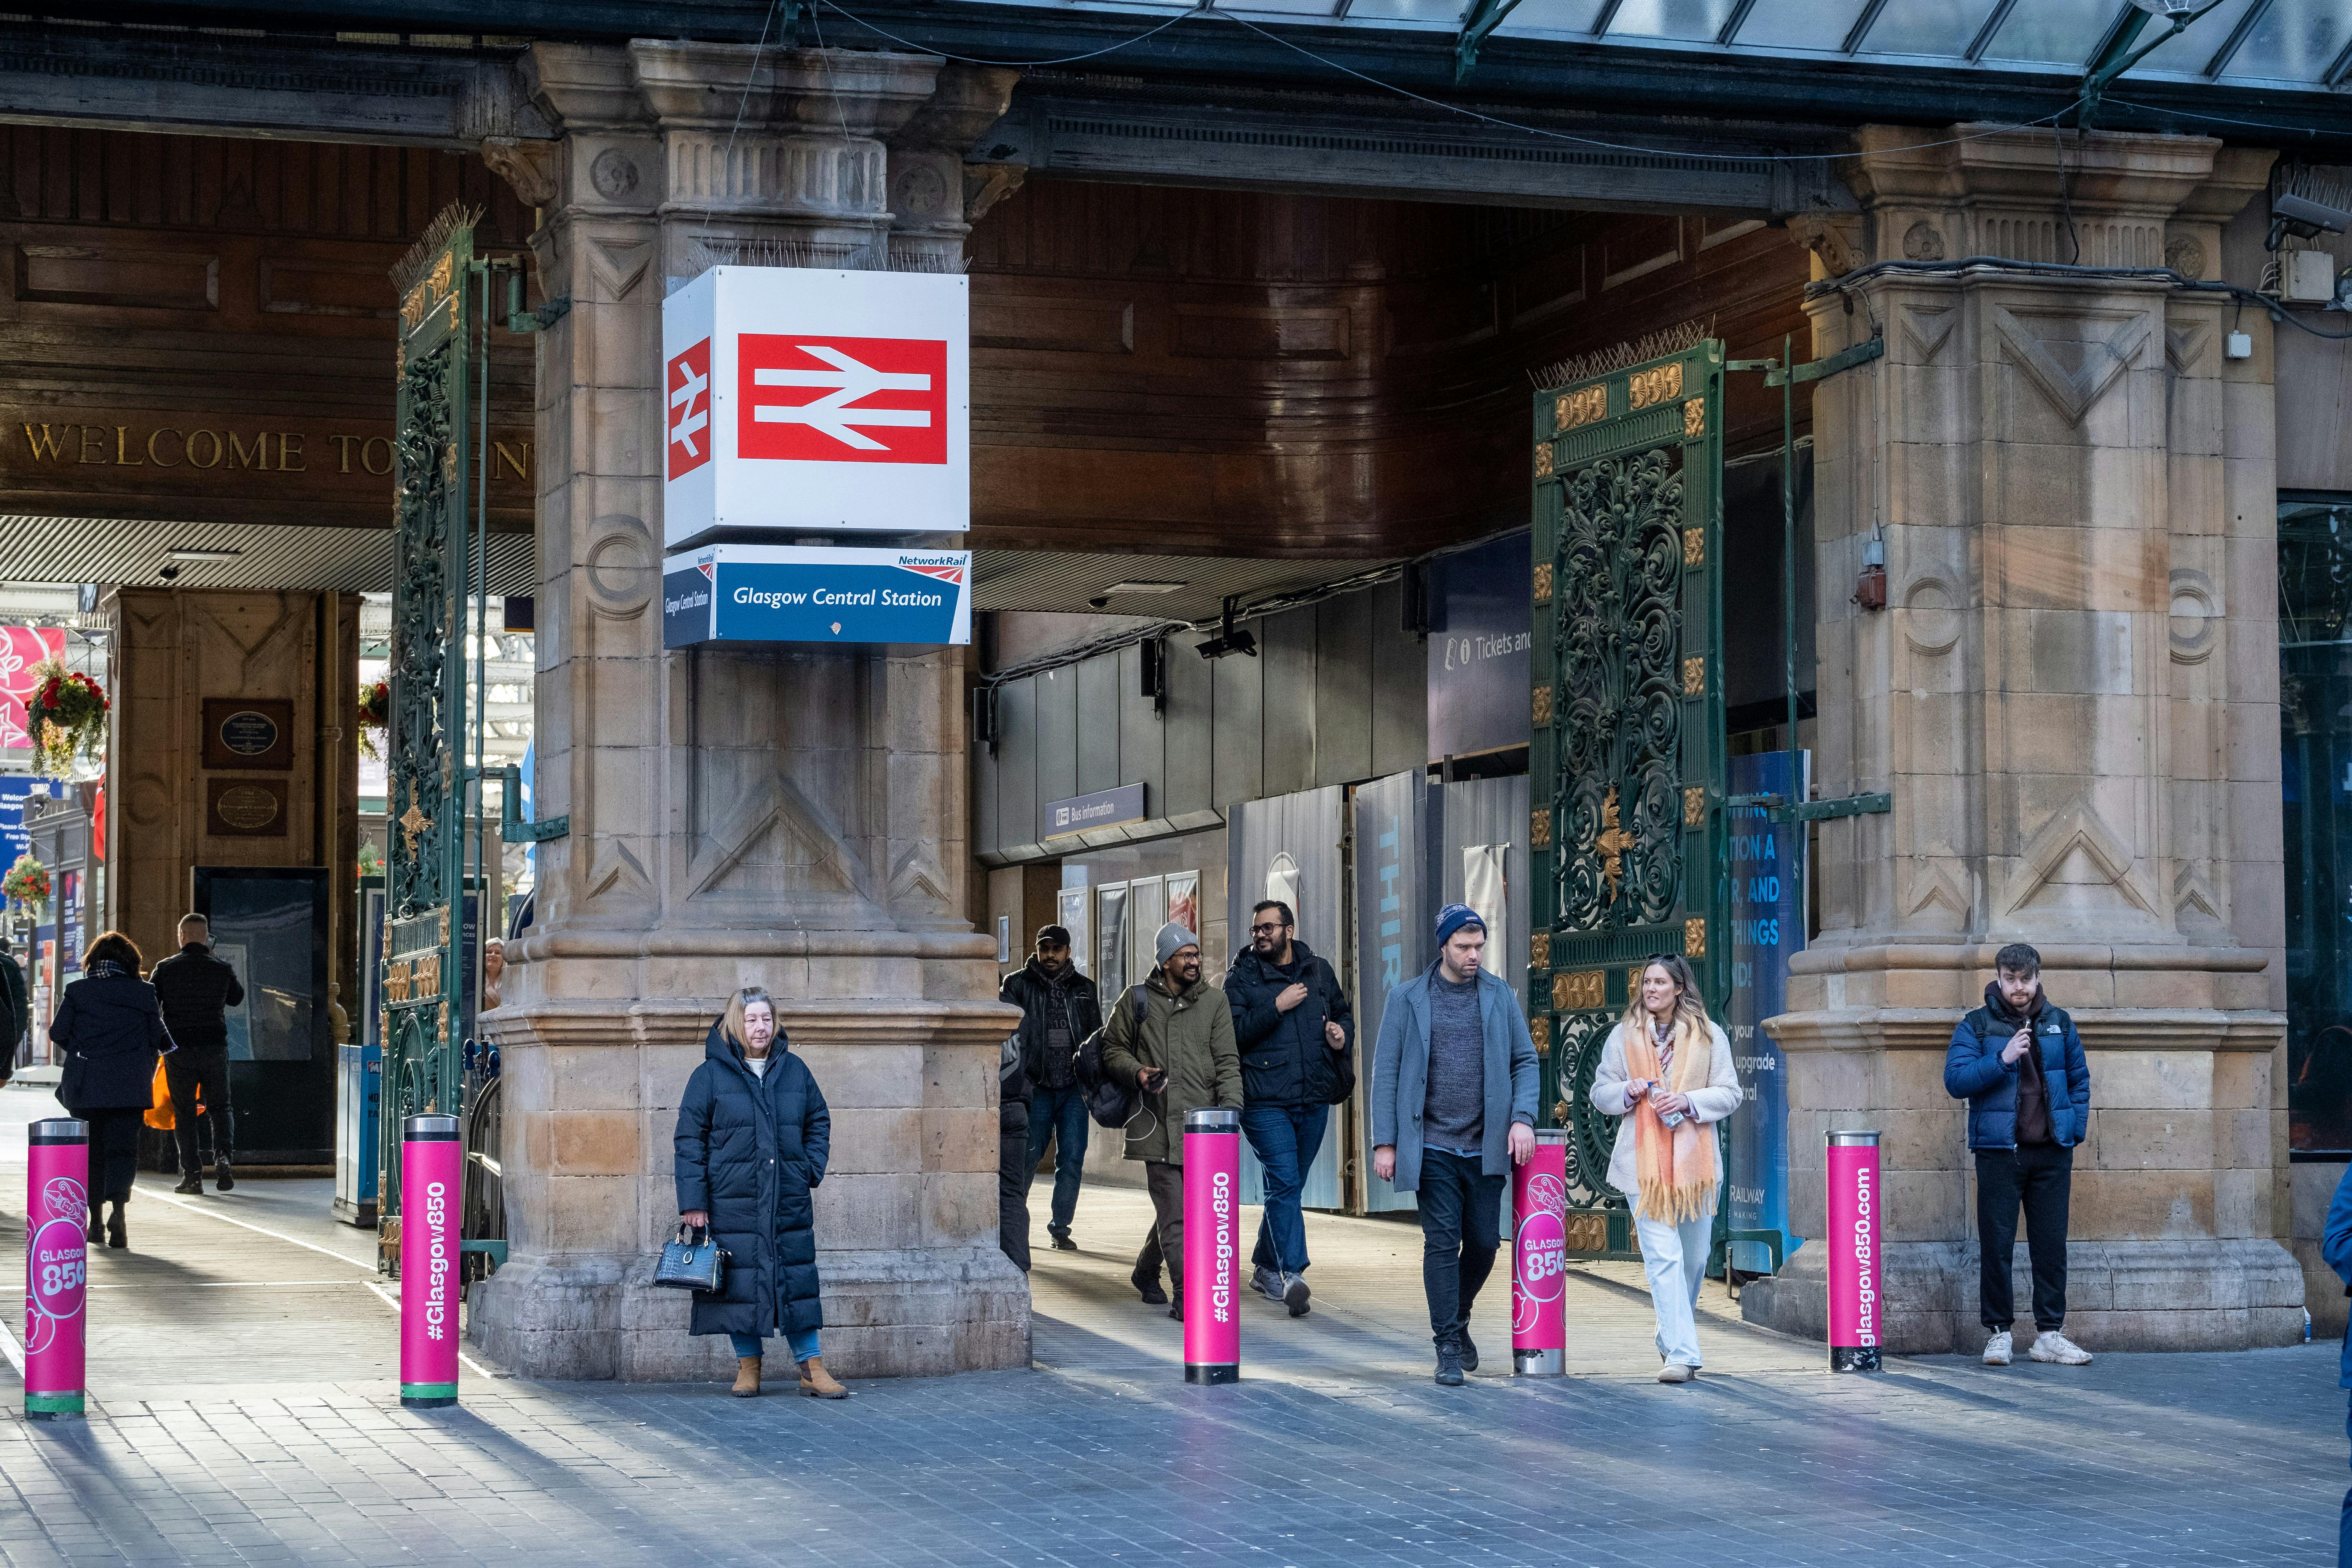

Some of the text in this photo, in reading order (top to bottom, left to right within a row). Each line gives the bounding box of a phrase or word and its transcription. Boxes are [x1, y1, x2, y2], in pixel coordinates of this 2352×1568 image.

[19, 422, 396, 475] WELCOME TO
[899, 556, 966, 566] NetworkRail
[665, 590, 708, 617] Glasgow Central Station
[734, 587, 942, 609] Glasgow Central Station
[1476, 633, 1512, 660] Tickets
[0, 802, 24, 811] lasgow
[1072, 800, 1114, 822] Bus information
[1764, 834, 1775, 859] A
[1748, 876, 1779, 902] AND
[1379, 815, 1401, 991] THIR
[1469, 901, 1480, 910] We've
[1734, 1025, 1754, 1042] your
[1736, 1053, 1775, 1074] upgrade
[1730, 1185, 1765, 1204] RAILWAY
[1734, 1210, 1757, 1220] MAKING
[40, 1248, 84, 1262] GLASGOW
[1212, 1172, 1233, 1323] #Glasgow850
[1525, 1238, 1564, 1251] GLASGOW
[425, 1182, 449, 1340] #Glasgow850
[1526, 1249, 1564, 1282] 850
[1855, 1167, 1876, 1347] glasgow850.com
[42, 1260, 85, 1296] 850
